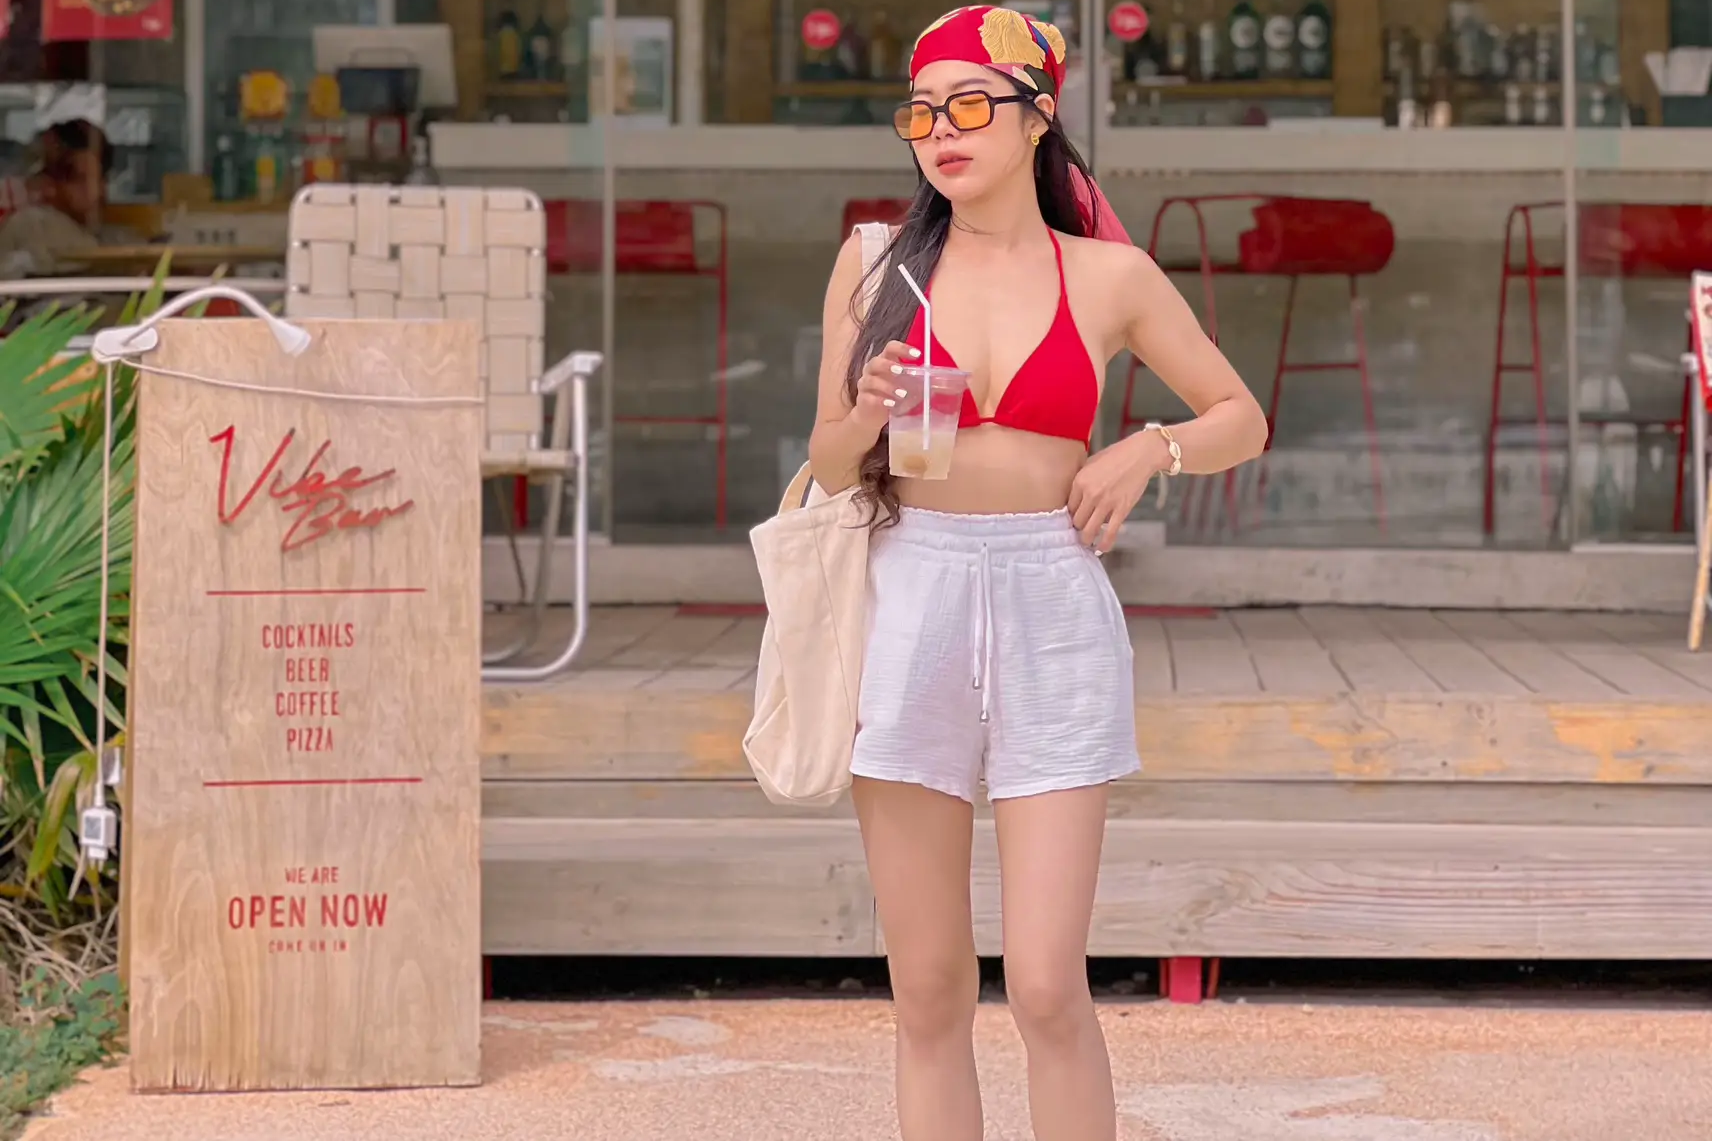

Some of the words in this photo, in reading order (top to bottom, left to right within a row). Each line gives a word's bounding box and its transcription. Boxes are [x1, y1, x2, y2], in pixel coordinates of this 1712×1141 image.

[209, 424, 396, 526] Vibe
[281, 490, 414, 553] Bar
[262, 622, 354, 649] COCKTAILS
[286, 657, 329, 682] BEER
[275, 691, 340, 717] COFFEE
[286, 726, 333, 752] PIZZA
[285, 866, 306, 884] WE
[311, 866, 339, 884] ARE
[228, 895, 306, 930] OPEN
[321, 892, 388, 928] NOW
